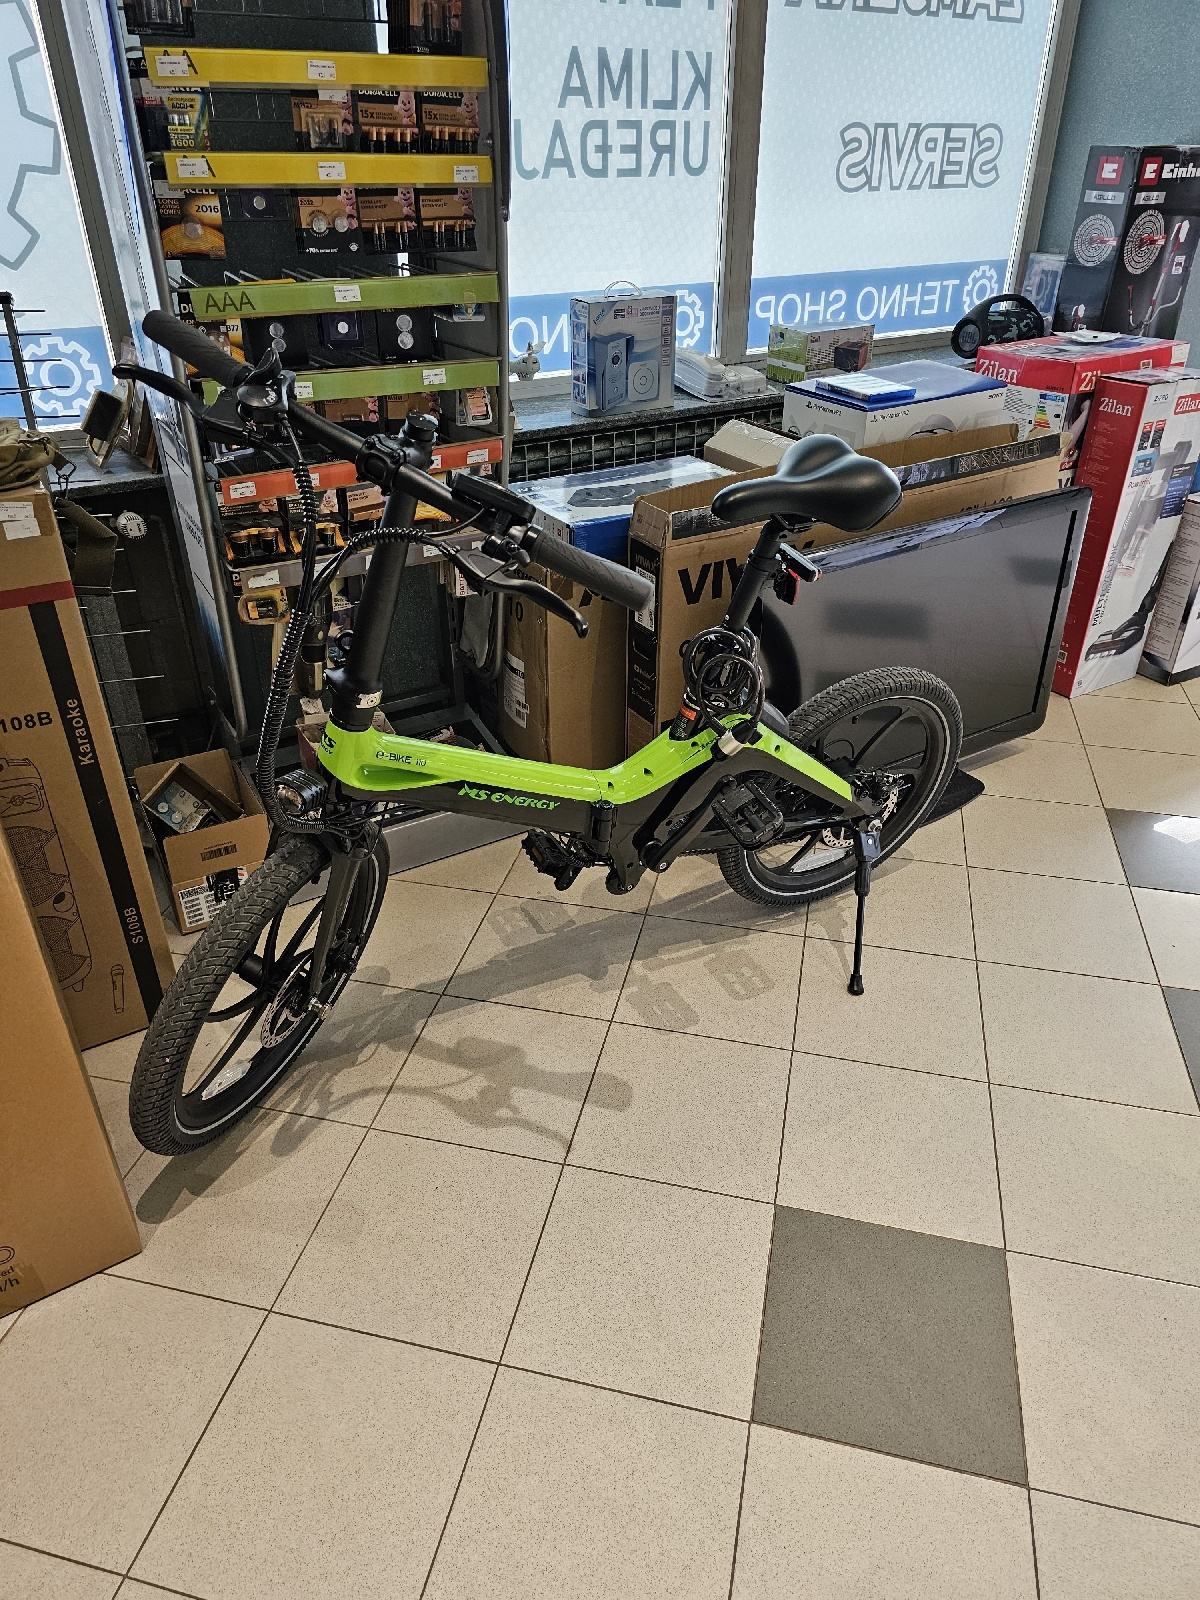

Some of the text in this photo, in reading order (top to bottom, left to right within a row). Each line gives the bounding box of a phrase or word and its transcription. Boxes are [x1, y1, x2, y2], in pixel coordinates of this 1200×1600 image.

[195, 204, 219, 214] 2016
[205, 290, 257, 314] AAA
[978, 358, 1018, 384] Zilan
[1099, 397, 1132, 417] Zilan
[67, 698, 95, 766] Karaoke
[375, 749, 413, 766] e-BIKE
[457, 783, 561, 811] MS ENERGY
[124, 906, 143, 944] S108B
